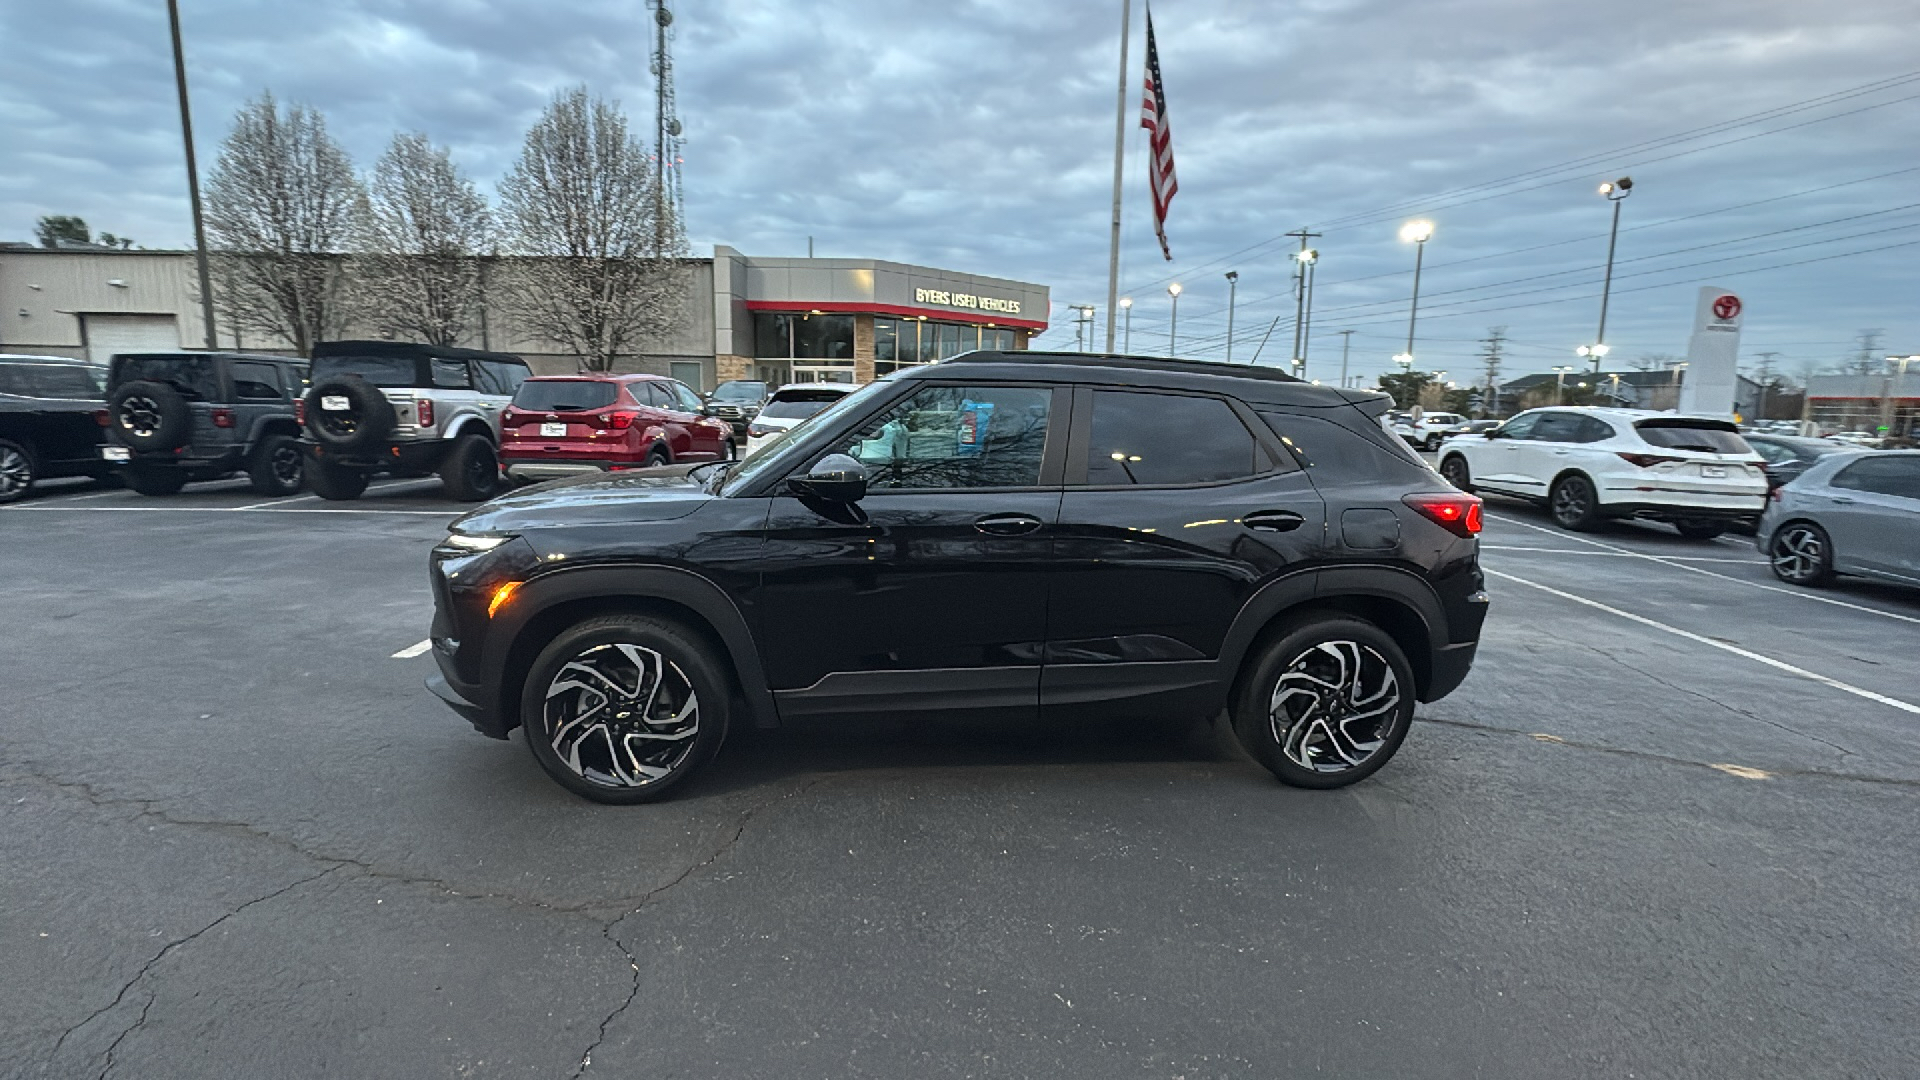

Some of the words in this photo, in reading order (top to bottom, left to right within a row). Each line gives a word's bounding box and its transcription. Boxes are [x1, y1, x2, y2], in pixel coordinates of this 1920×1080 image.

[915, 288, 950, 305] BYERS
[951, 293, 977, 308] USED
[978, 296, 1020, 313] VEHICLES
